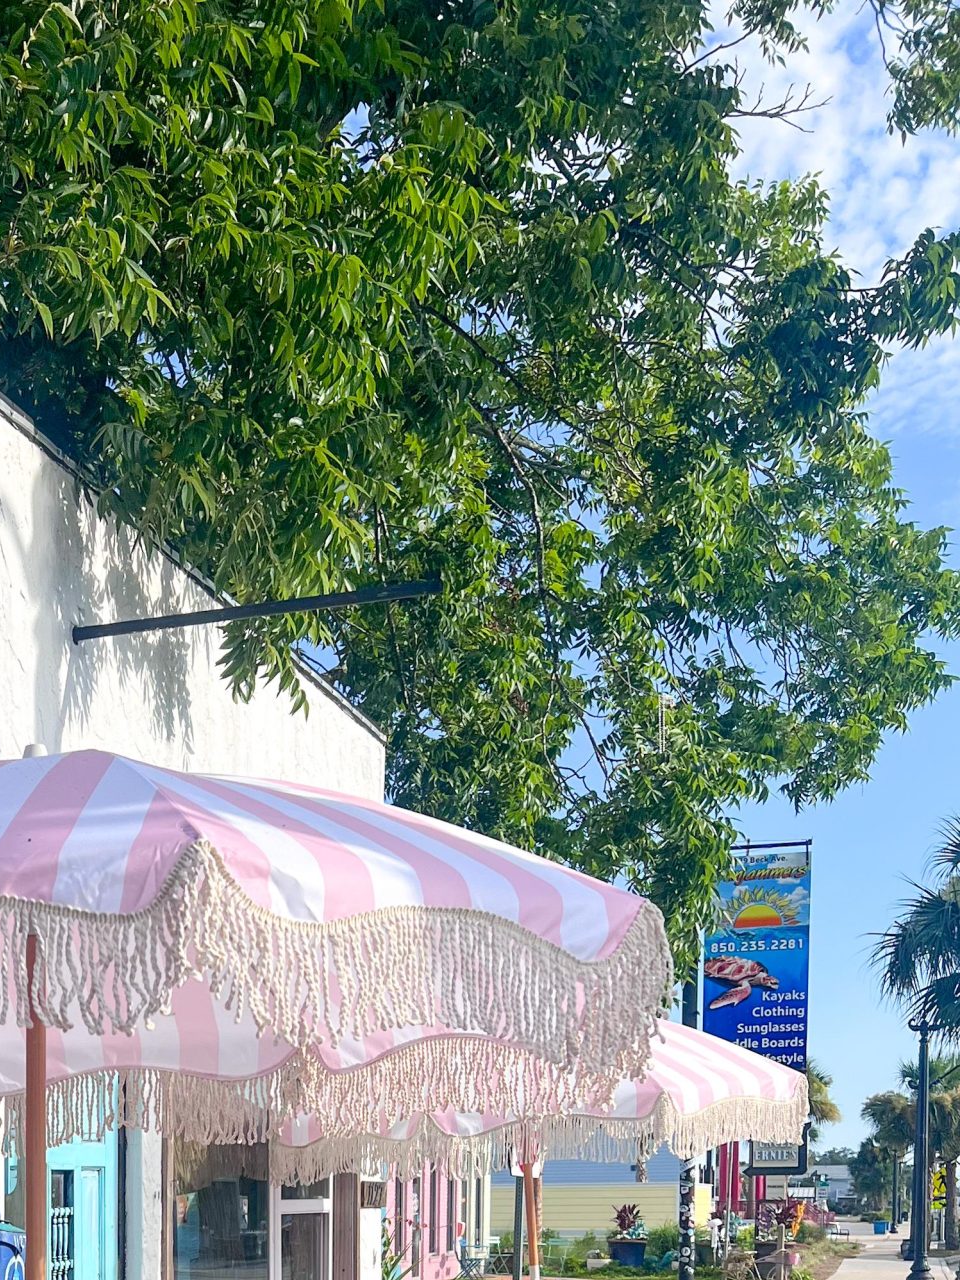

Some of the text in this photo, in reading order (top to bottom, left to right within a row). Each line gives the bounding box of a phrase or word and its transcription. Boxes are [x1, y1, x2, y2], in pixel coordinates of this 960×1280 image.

[749, 855, 769, 864] Beck
[734, 866, 808, 886] jammers
[711, 938, 804, 953] 850.235.2281
[762, 989, 806, 1003] Kayaks
[751, 1005, 805, 1018] Clothing
[736, 1021, 805, 1035] Sunglasses
[732, 1035, 805, 1049] ddle Boards
[754, 1149, 798, 1161] ERNIE'S
